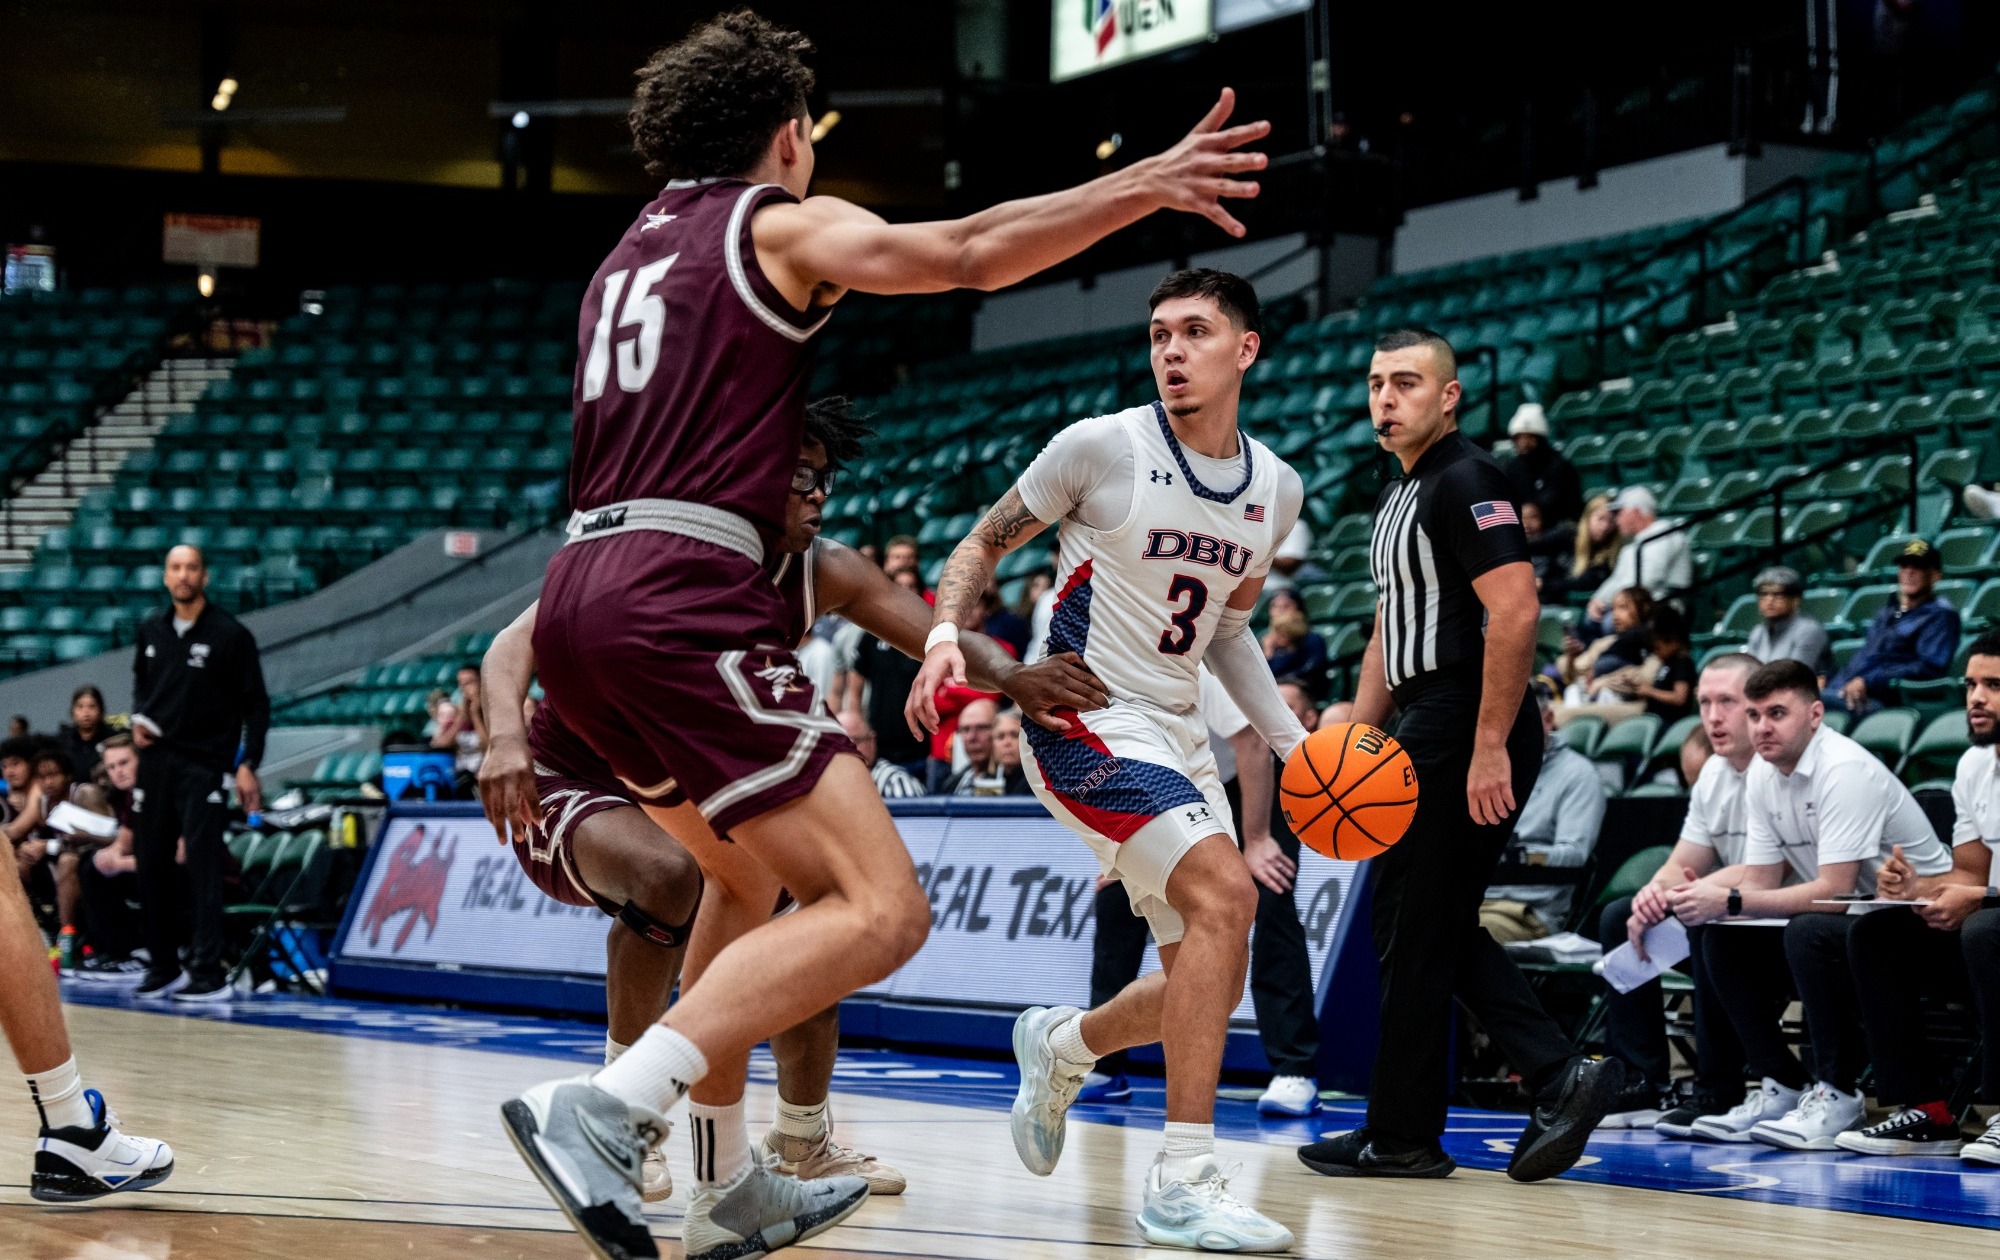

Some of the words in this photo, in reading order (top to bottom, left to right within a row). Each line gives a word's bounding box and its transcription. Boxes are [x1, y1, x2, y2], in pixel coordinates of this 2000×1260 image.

[583, 252, 680, 402] 15
[1142, 529, 1253, 577] DBU
[1158, 573, 1208, 656] 3
[1071, 758, 1120, 799] DBU
